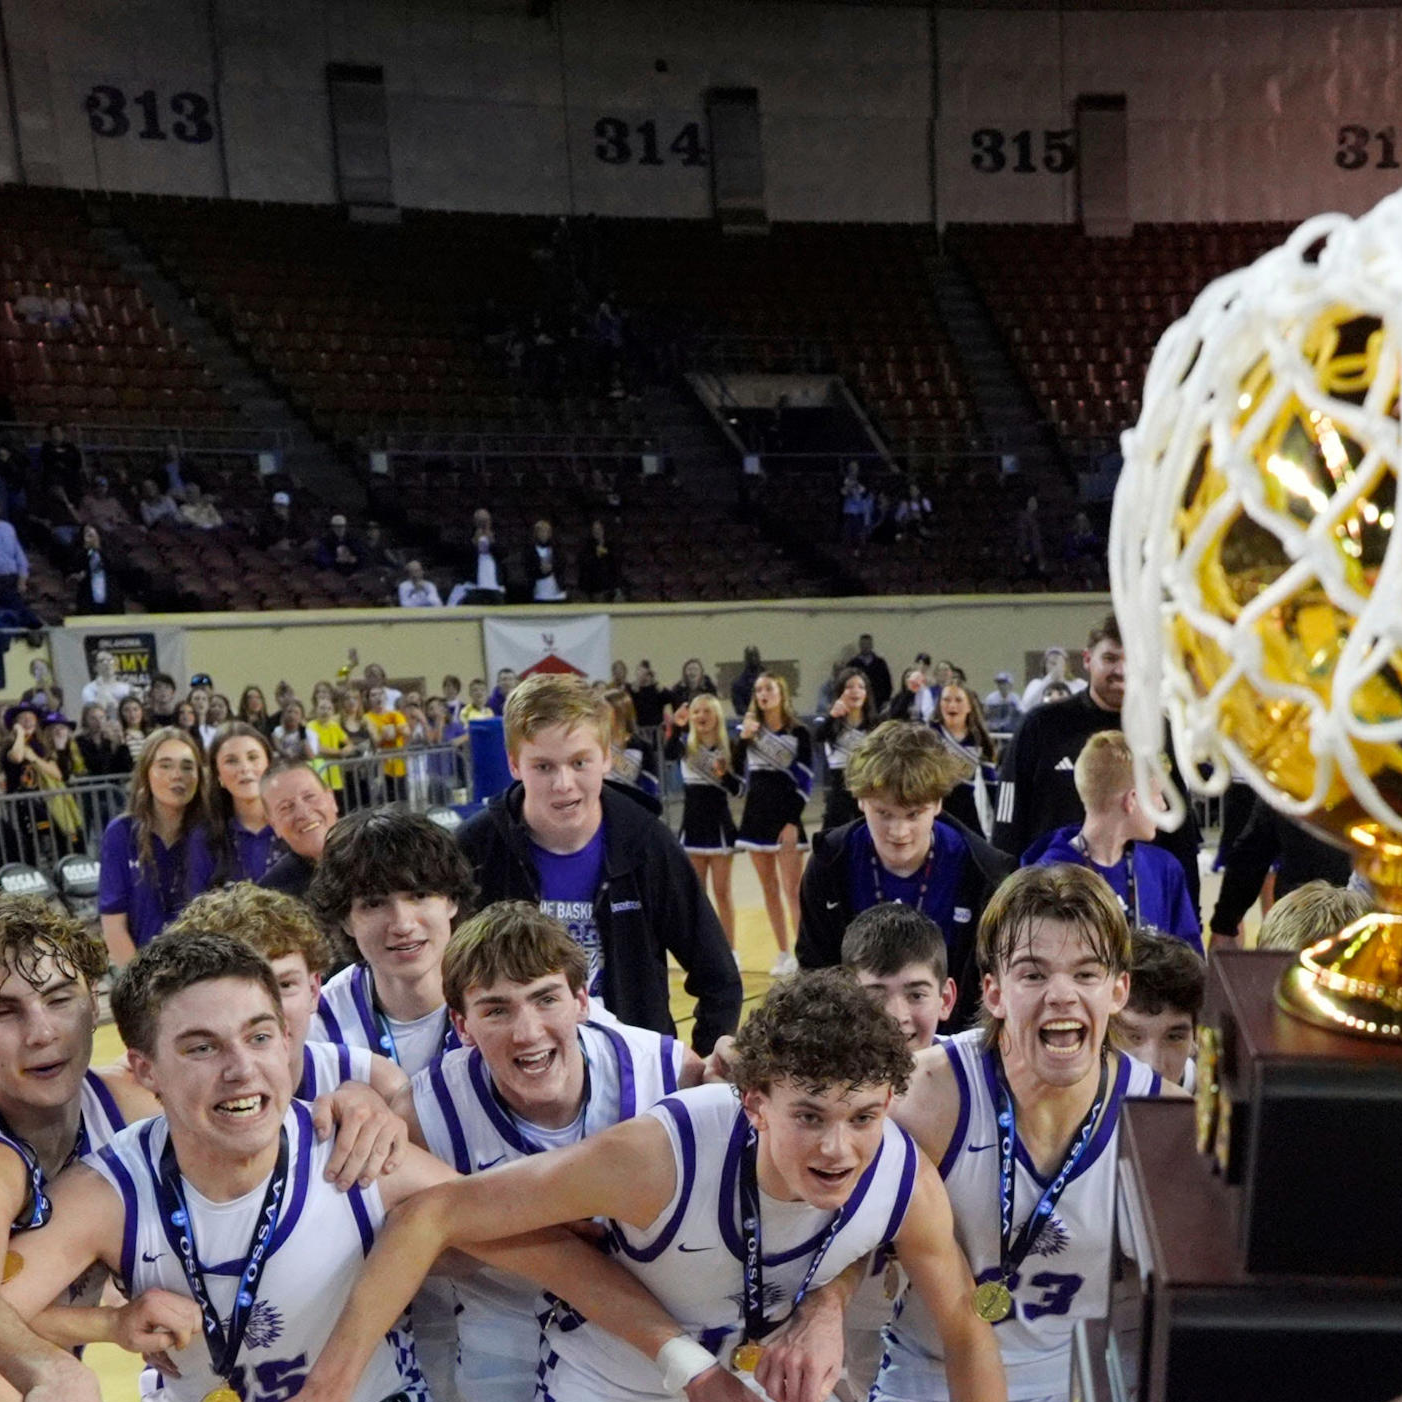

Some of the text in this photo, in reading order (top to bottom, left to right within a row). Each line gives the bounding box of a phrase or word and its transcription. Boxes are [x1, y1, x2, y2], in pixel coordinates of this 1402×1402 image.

[86, 85, 213, 144] 313
[595, 117, 710, 166] 314
[971, 128, 1079, 173] 315
[1001, 1135, 1013, 1236] OSSAA
[1052, 1102, 1101, 1194] OSSAA
[247, 1177, 283, 1283] OSSAA
[179, 1235, 216, 1335] OSSAA
[747, 1236, 759, 1311] OSSAA
